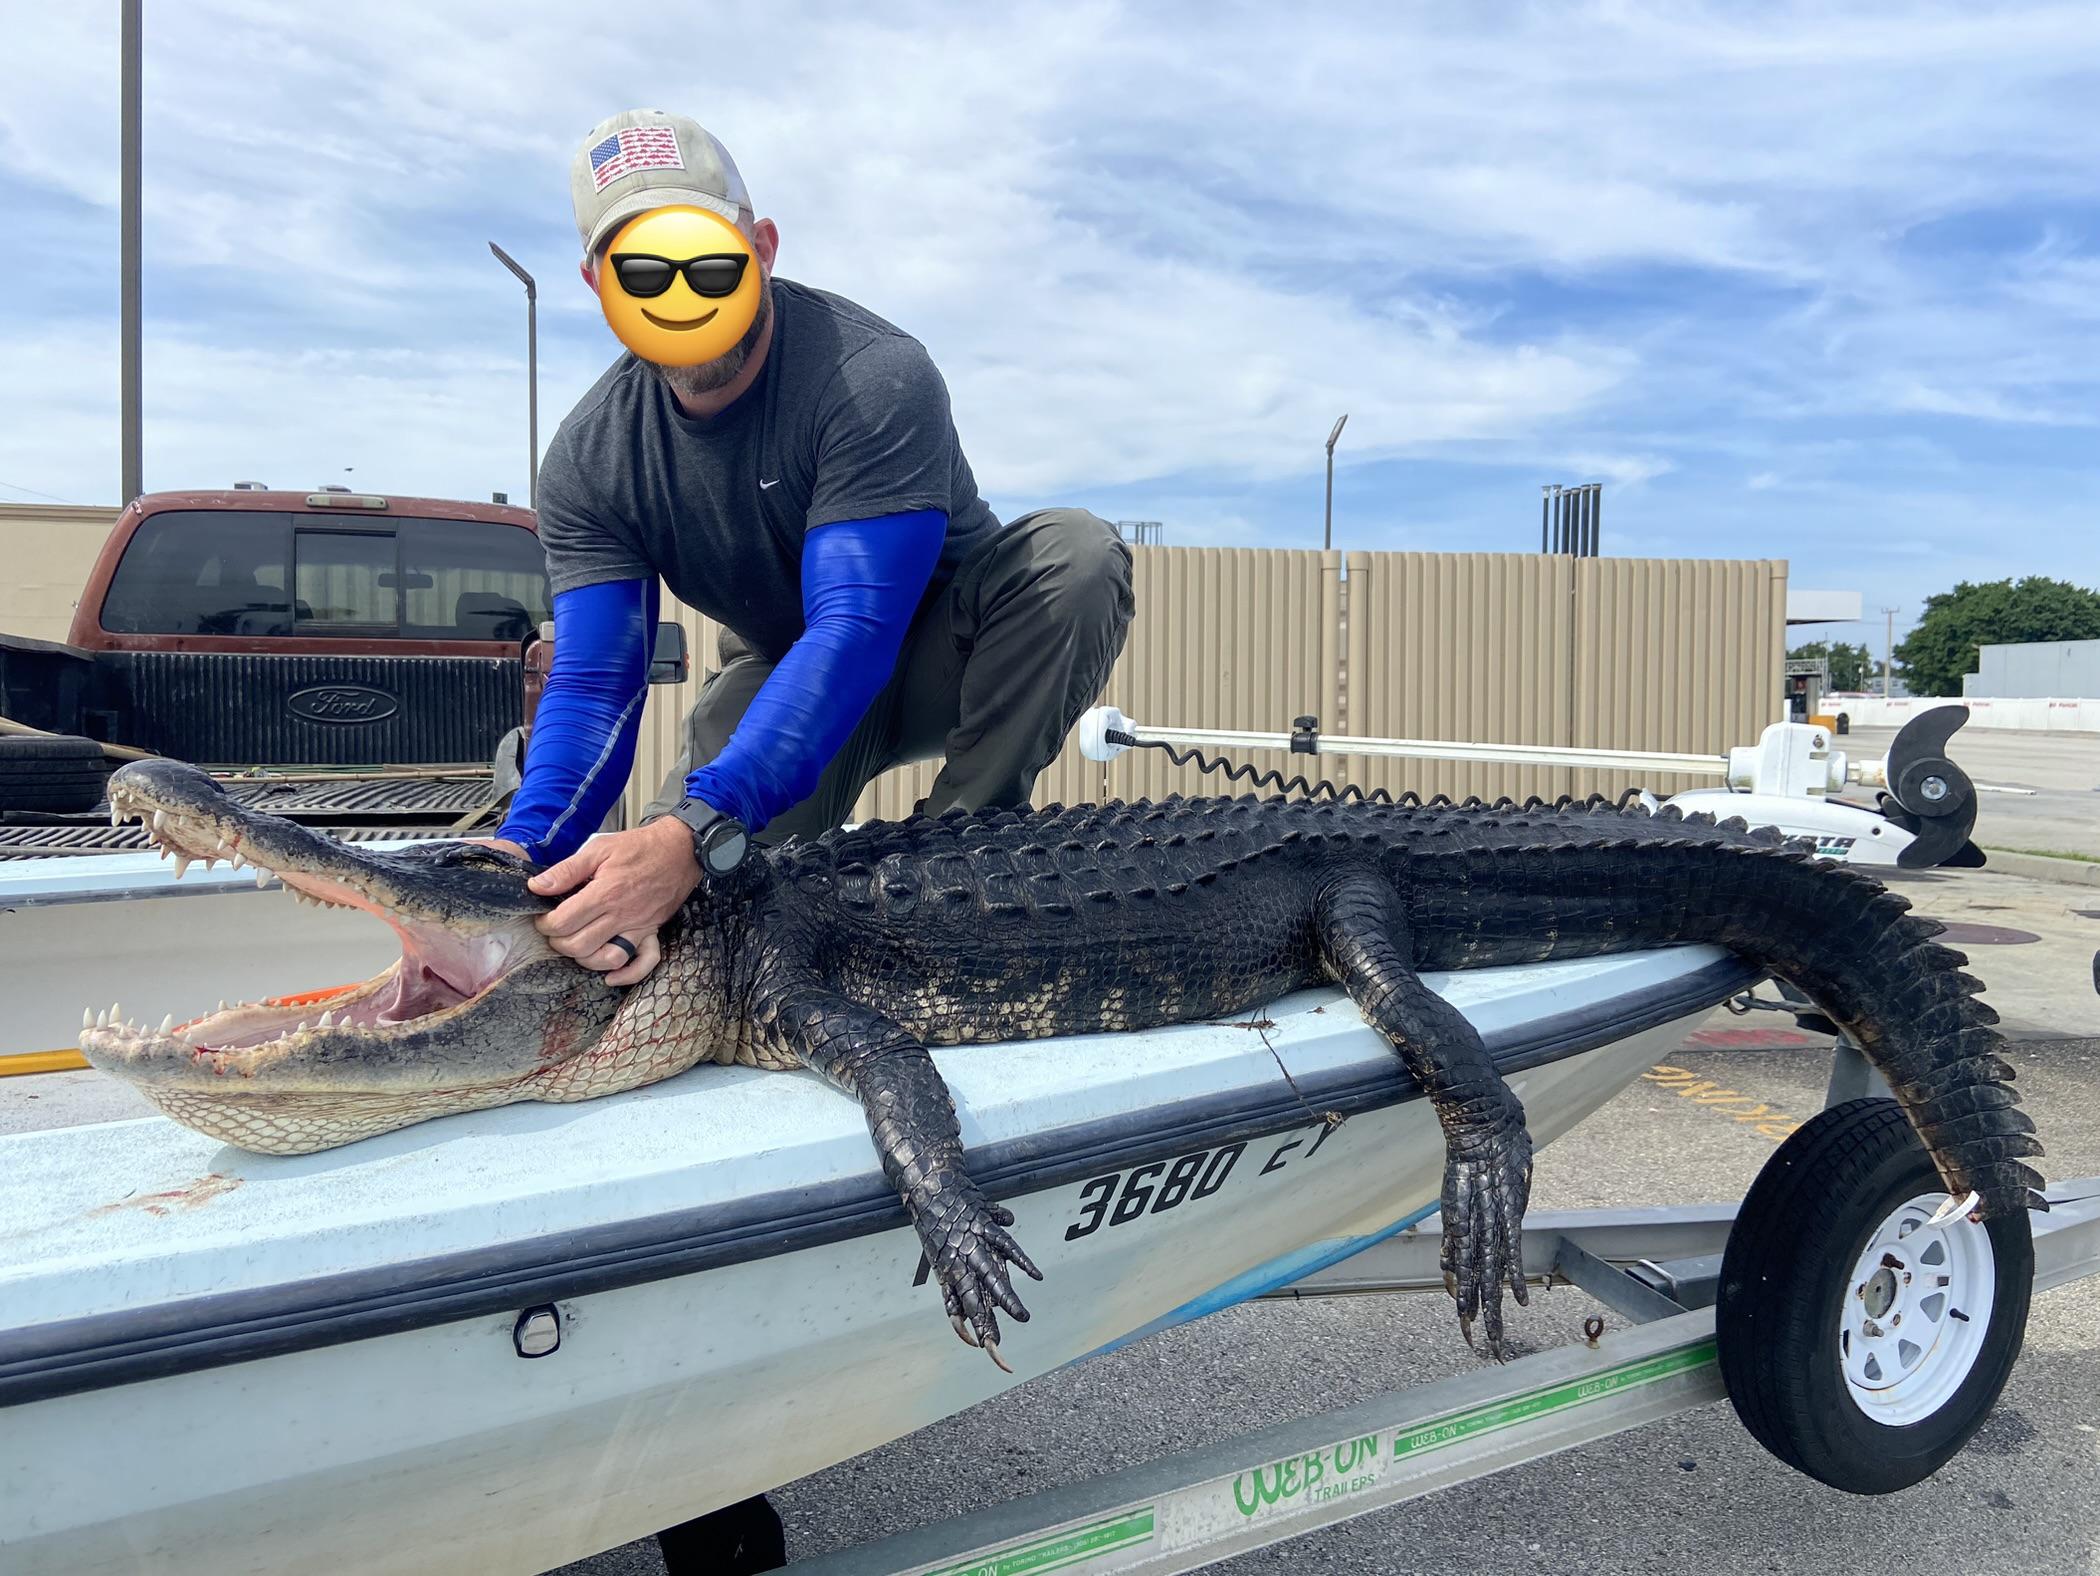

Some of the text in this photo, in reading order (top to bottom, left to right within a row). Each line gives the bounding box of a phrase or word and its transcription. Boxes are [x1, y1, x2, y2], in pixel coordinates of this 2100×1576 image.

[311, 690, 376, 715] Ford
[1064, 1141, 1249, 1242] 3680
[1577, 1375, 1619, 1398] WEB-ON
[1410, 1424, 1458, 1449] WEB-ON
[1232, 1435, 1379, 1517] WEB-ON
